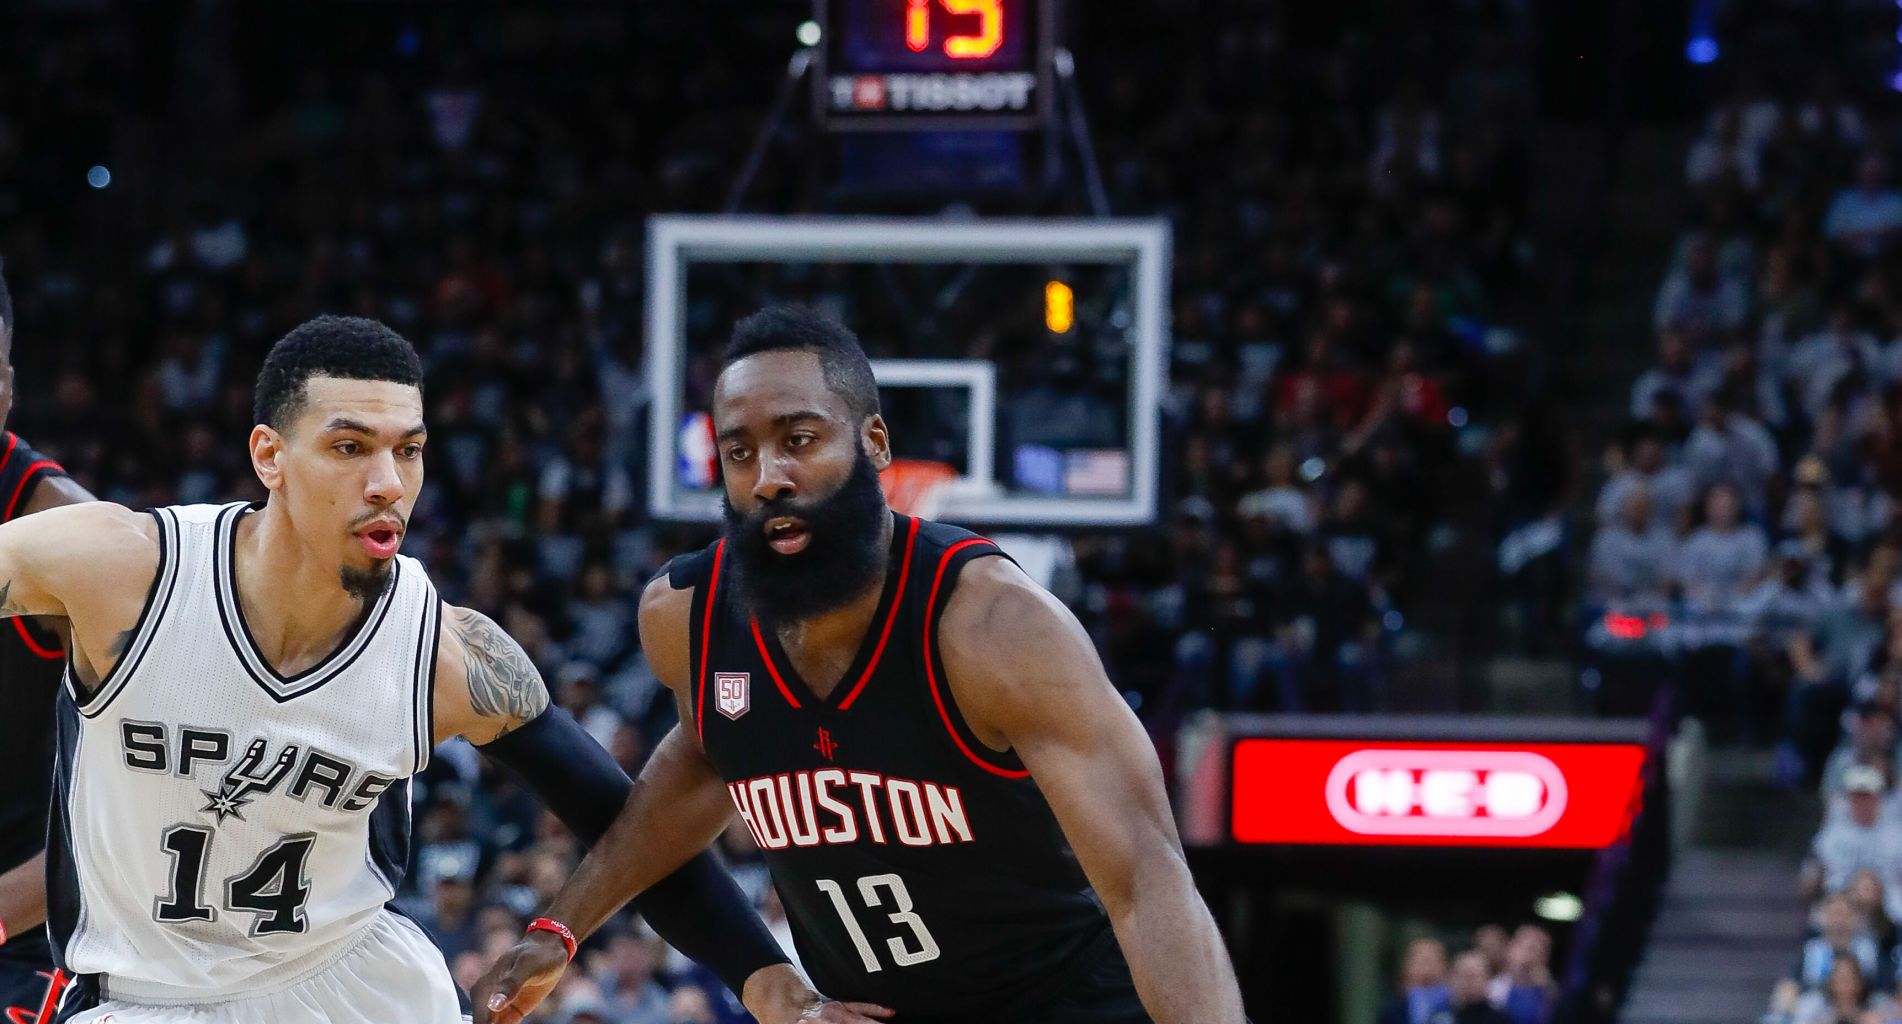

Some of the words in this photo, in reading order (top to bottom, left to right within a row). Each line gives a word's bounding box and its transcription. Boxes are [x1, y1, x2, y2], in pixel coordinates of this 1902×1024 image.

[887, 73, 1036, 111] TISSOT
[721, 680, 743, 699] 50
[119, 717, 397, 826] SPURS
[726, 768, 976, 850] HOUSTON
[152, 822, 317, 938] 14
[815, 873, 941, 973] 13
